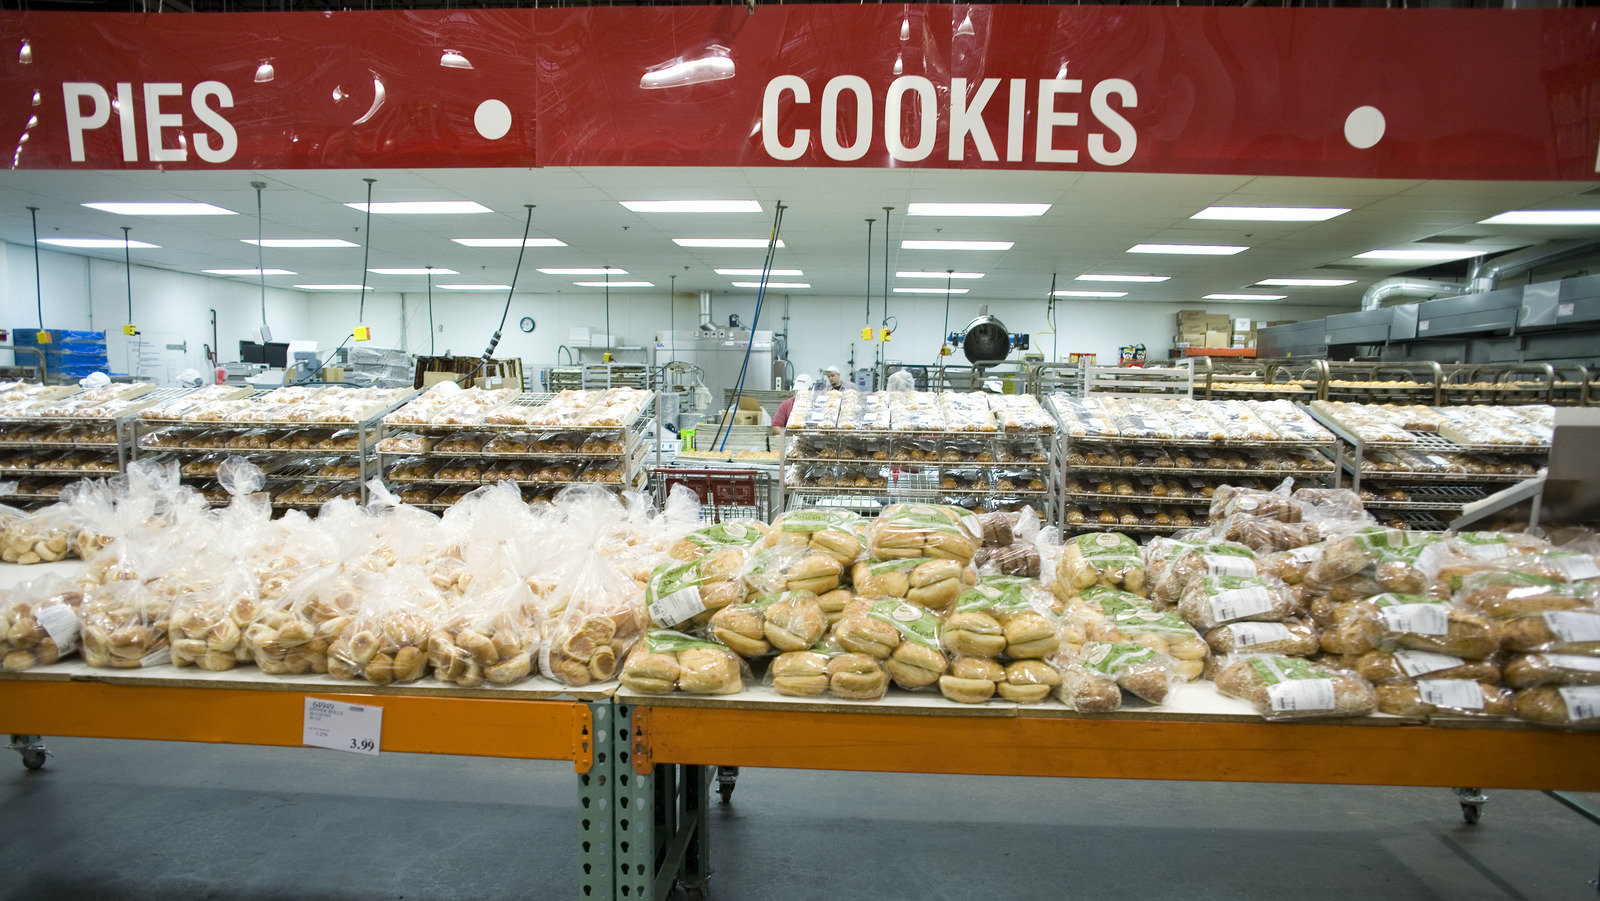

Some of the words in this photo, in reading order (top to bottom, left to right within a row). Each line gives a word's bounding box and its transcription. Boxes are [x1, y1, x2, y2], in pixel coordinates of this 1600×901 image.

[64, 81, 237, 163] PIES
[762, 75, 1137, 165] COOKIES
[911, 624, 935, 637] Bread
[350, 738, 375, 751] 3.99
